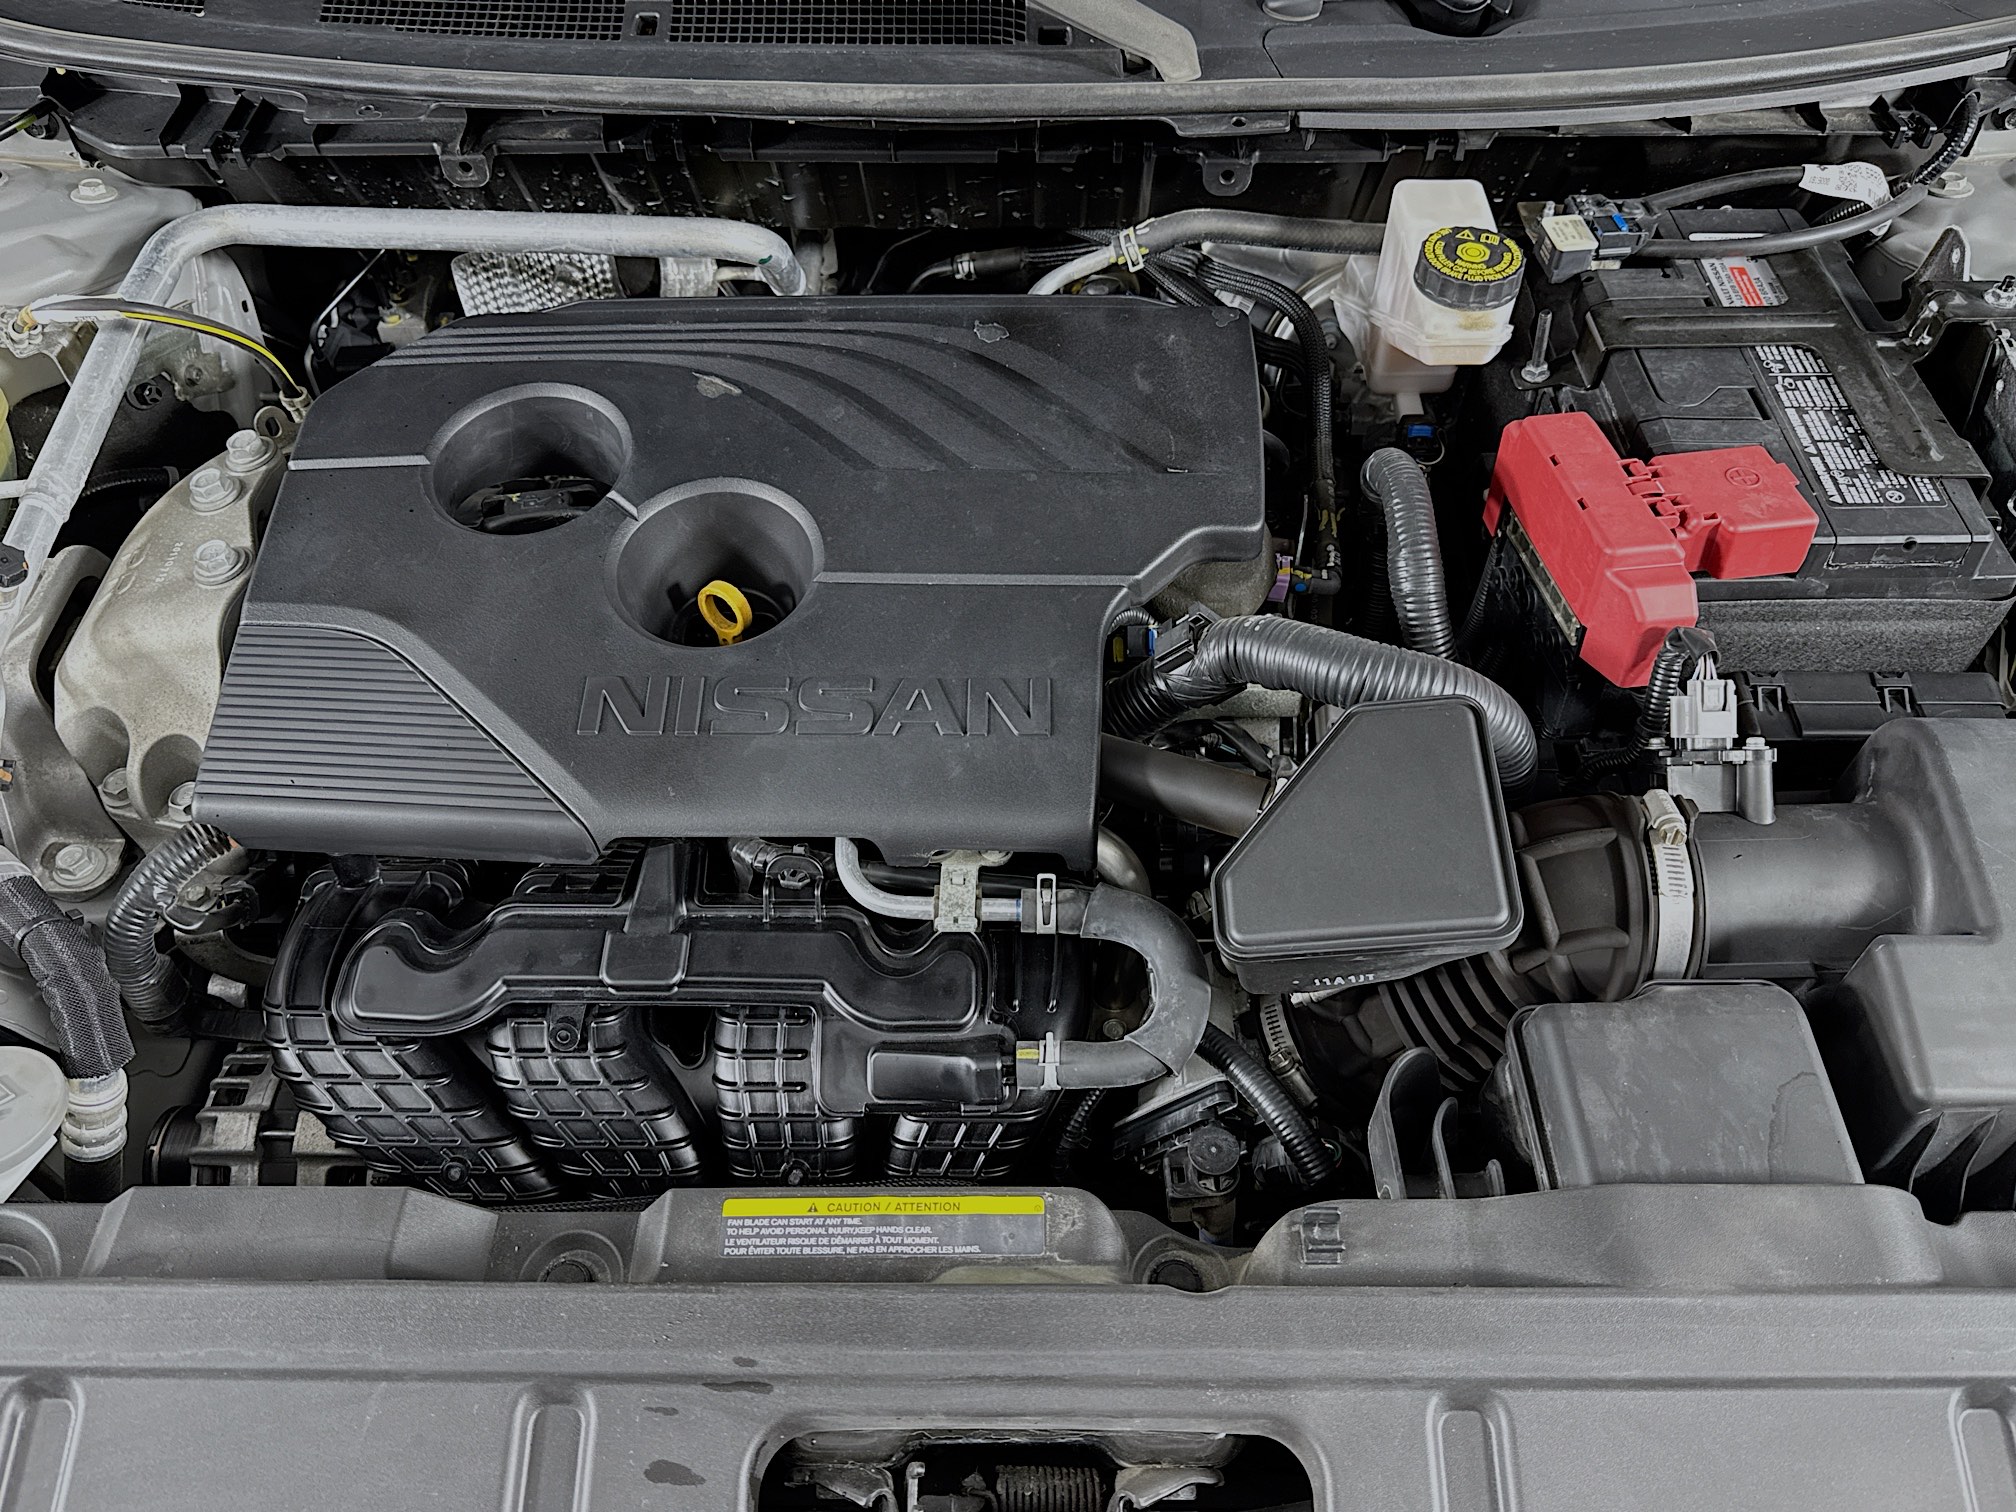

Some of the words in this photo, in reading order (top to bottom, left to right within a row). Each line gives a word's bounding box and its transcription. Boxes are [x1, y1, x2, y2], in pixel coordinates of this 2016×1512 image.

[1453, 265, 1467, 273] CAP
[1463, 273, 1483, 282] FLUID
[1708, 262, 1726, 287] NISSAN
[576, 675, 1055, 736] NISSAN
[827, 1202, 880, 1212] CAUTION
[885, 1202, 891, 1212] /
[895, 1202, 960, 1212] ATTENTION
[727, 1218, 743, 1226] FAN
[744, 1218, 770, 1226] BLADE
[771, 1218, 788, 1226] CAN
[825, 1217, 842, 1225] ANY
[843, 1217, 862, 1225] TIME.
[727, 1227, 738, 1235] TO
[739, 1227, 760, 1235] HELP
[760, 1227, 784, 1235] AVOID
[785, 1227, 827, 1235] PERSONAL
[876, 1226, 904, 1234] HANDS
[904, 1226, 932, 1234] CLEAR.
[725, 1238, 735, 1246] LE
[736, 1238, 787, 1246] VENTILATEUR
[787, 1237, 817, 1245] RISQUE
[818, 1237, 830, 1245] DE
[830, 1235, 874, 1245] DÉMARRER
[874, 1234, 881, 1244] À
[881, 1236, 903, 1244] TOUT
[903, 1236, 939, 1244] MOMENT.
[723, 1247, 747, 1255] POUR
[748, 1245, 775, 1255] ÉVITER
[776, 1247, 802, 1255] TOUTE
[802, 1246, 845, 1255] BLESSURE,
[847, 1246, 858, 1254] NE
[859, 1246, 875, 1254] PAS
[876, 1245, 887, 1253] EN
[888, 1245, 938, 1254] APPROCHER
[938, 1246, 953, 1254] LES
[954, 1245, 981, 1253] MAINS.
